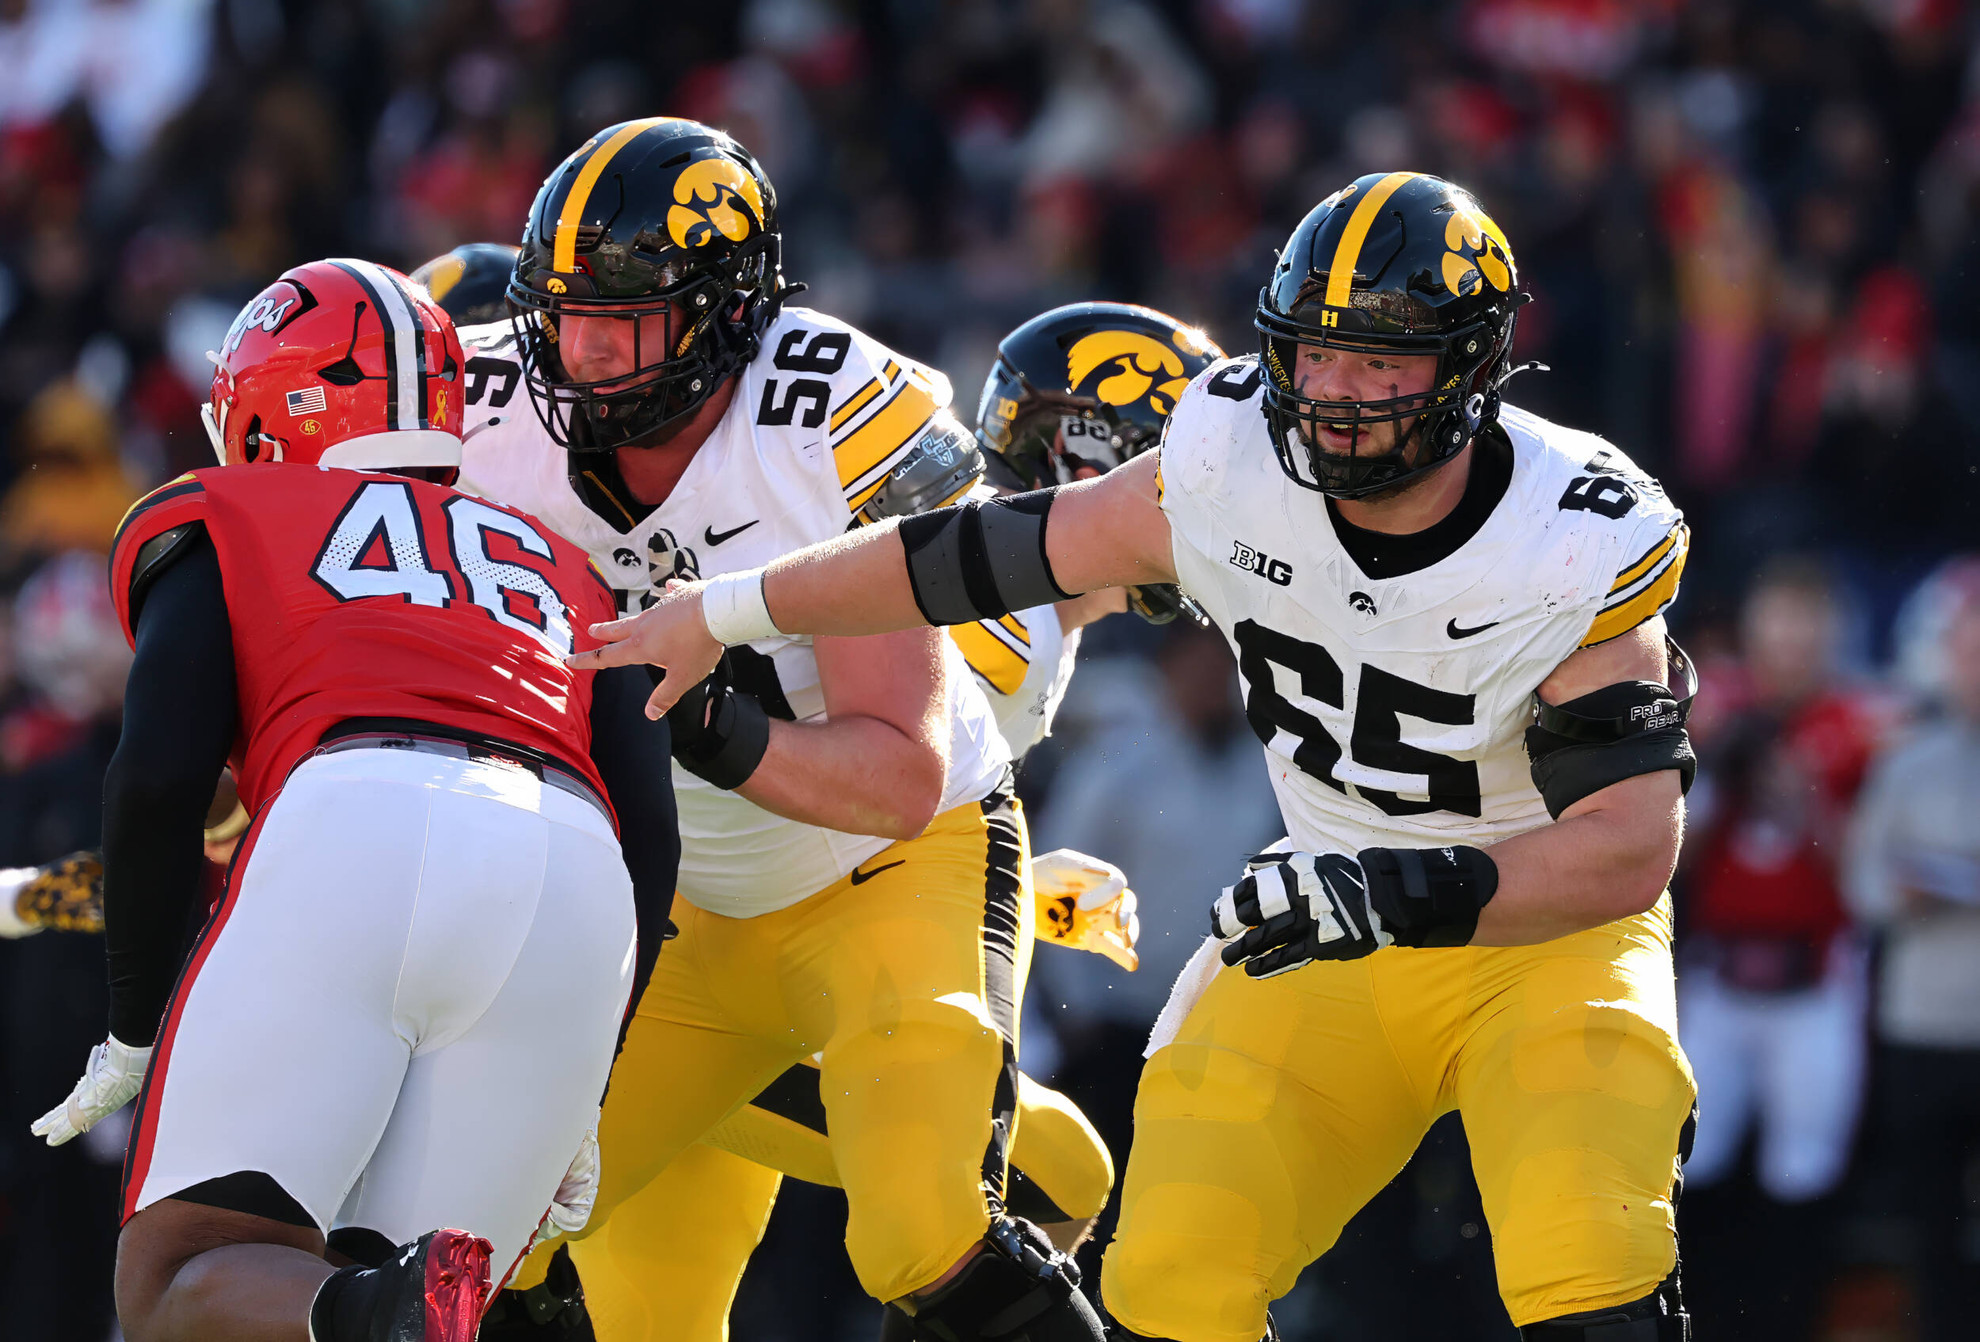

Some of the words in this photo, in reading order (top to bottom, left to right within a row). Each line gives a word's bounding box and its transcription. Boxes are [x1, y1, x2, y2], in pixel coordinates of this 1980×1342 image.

[757, 329, 852, 429] 56
[308, 480, 577, 663] 46
[1234, 618, 1482, 818] 65
[1631, 703, 1662, 721] PRO
[1645, 711, 1679, 730] GEAR
